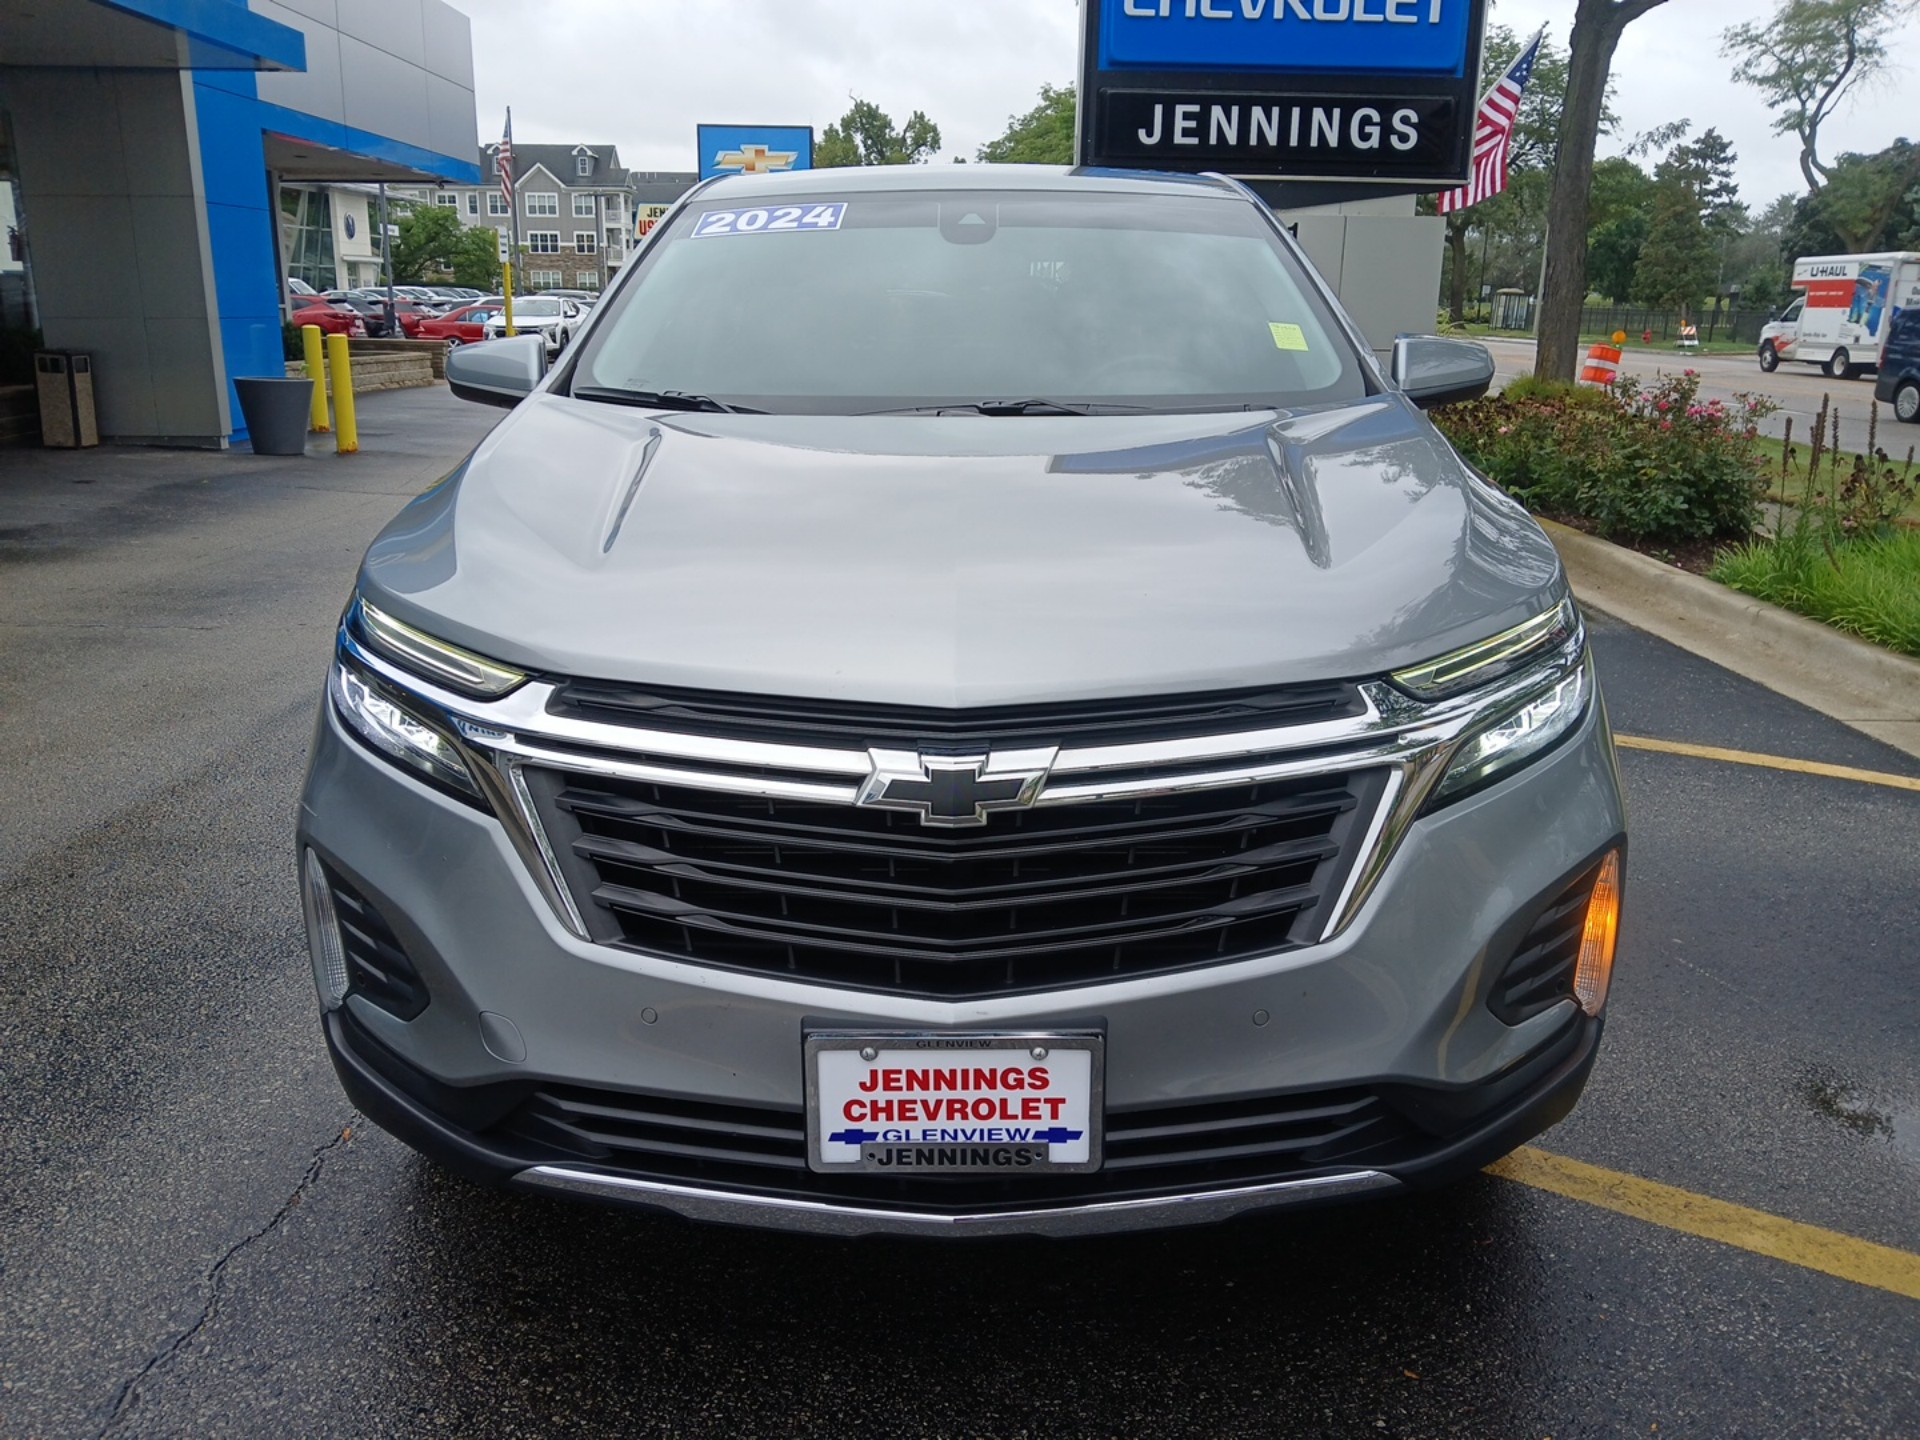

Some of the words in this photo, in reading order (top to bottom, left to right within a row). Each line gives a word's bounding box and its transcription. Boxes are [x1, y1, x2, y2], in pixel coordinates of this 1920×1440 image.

[1138, 104, 1419, 151] JENNINGS
[646, 206, 669, 218] JEN
[700, 206, 835, 234] 2024
[1810, 265, 1848, 278] U-HAUL
[915, 1039, 993, 1049] GLENVIEW
[858, 1067, 1050, 1092] JENNINGS
[842, 1097, 1067, 1122] CHEVROLET
[882, 1127, 1031, 1143] GLENVIEW
[877, 1147, 1033, 1167] JENNINGS
